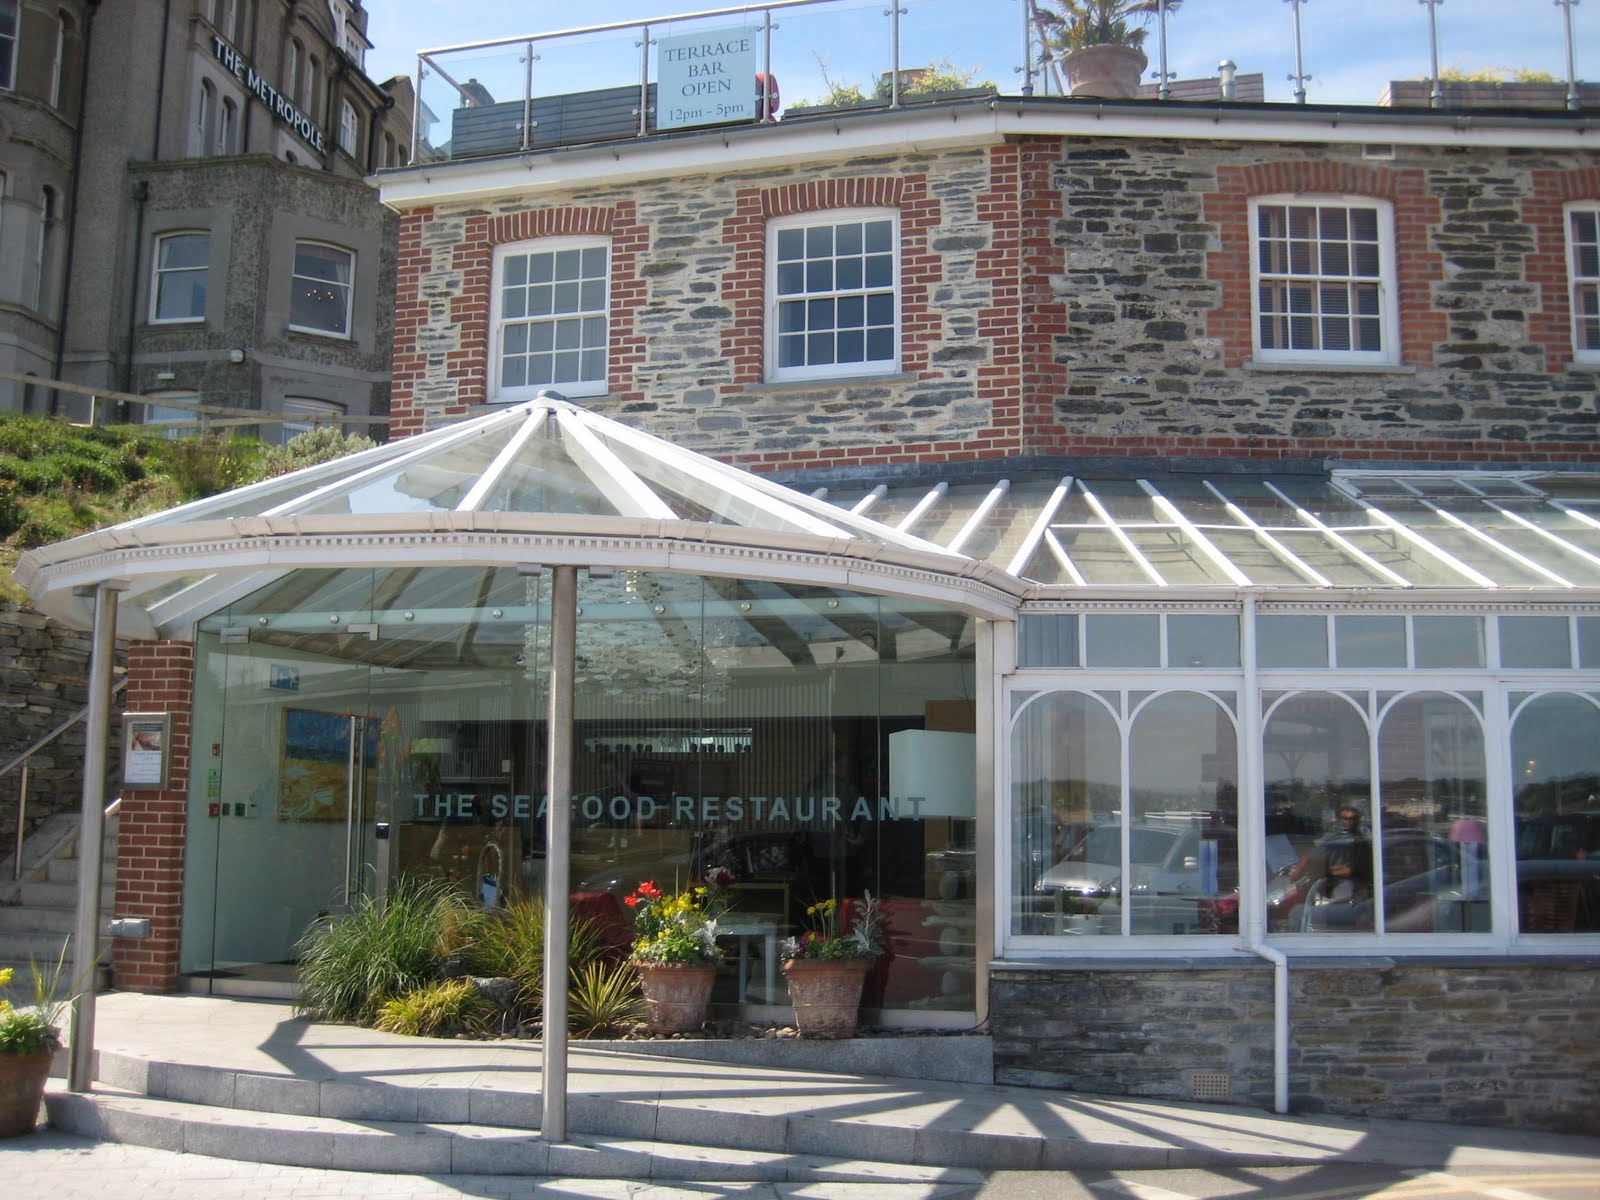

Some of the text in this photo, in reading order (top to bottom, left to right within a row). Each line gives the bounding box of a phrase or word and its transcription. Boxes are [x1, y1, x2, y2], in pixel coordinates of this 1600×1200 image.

[665, 39, 749, 62] TERRACE
[688, 62, 725, 78] BAR
[214, 36, 323, 151] THE METROPOLE
[682, 79, 731, 96] OPEN
[669, 109, 703, 122] 12pm
[716, 103, 744, 117] 5pm
[413, 793, 474, 818] THE
[675, 796, 927, 822] RESTAURANT
